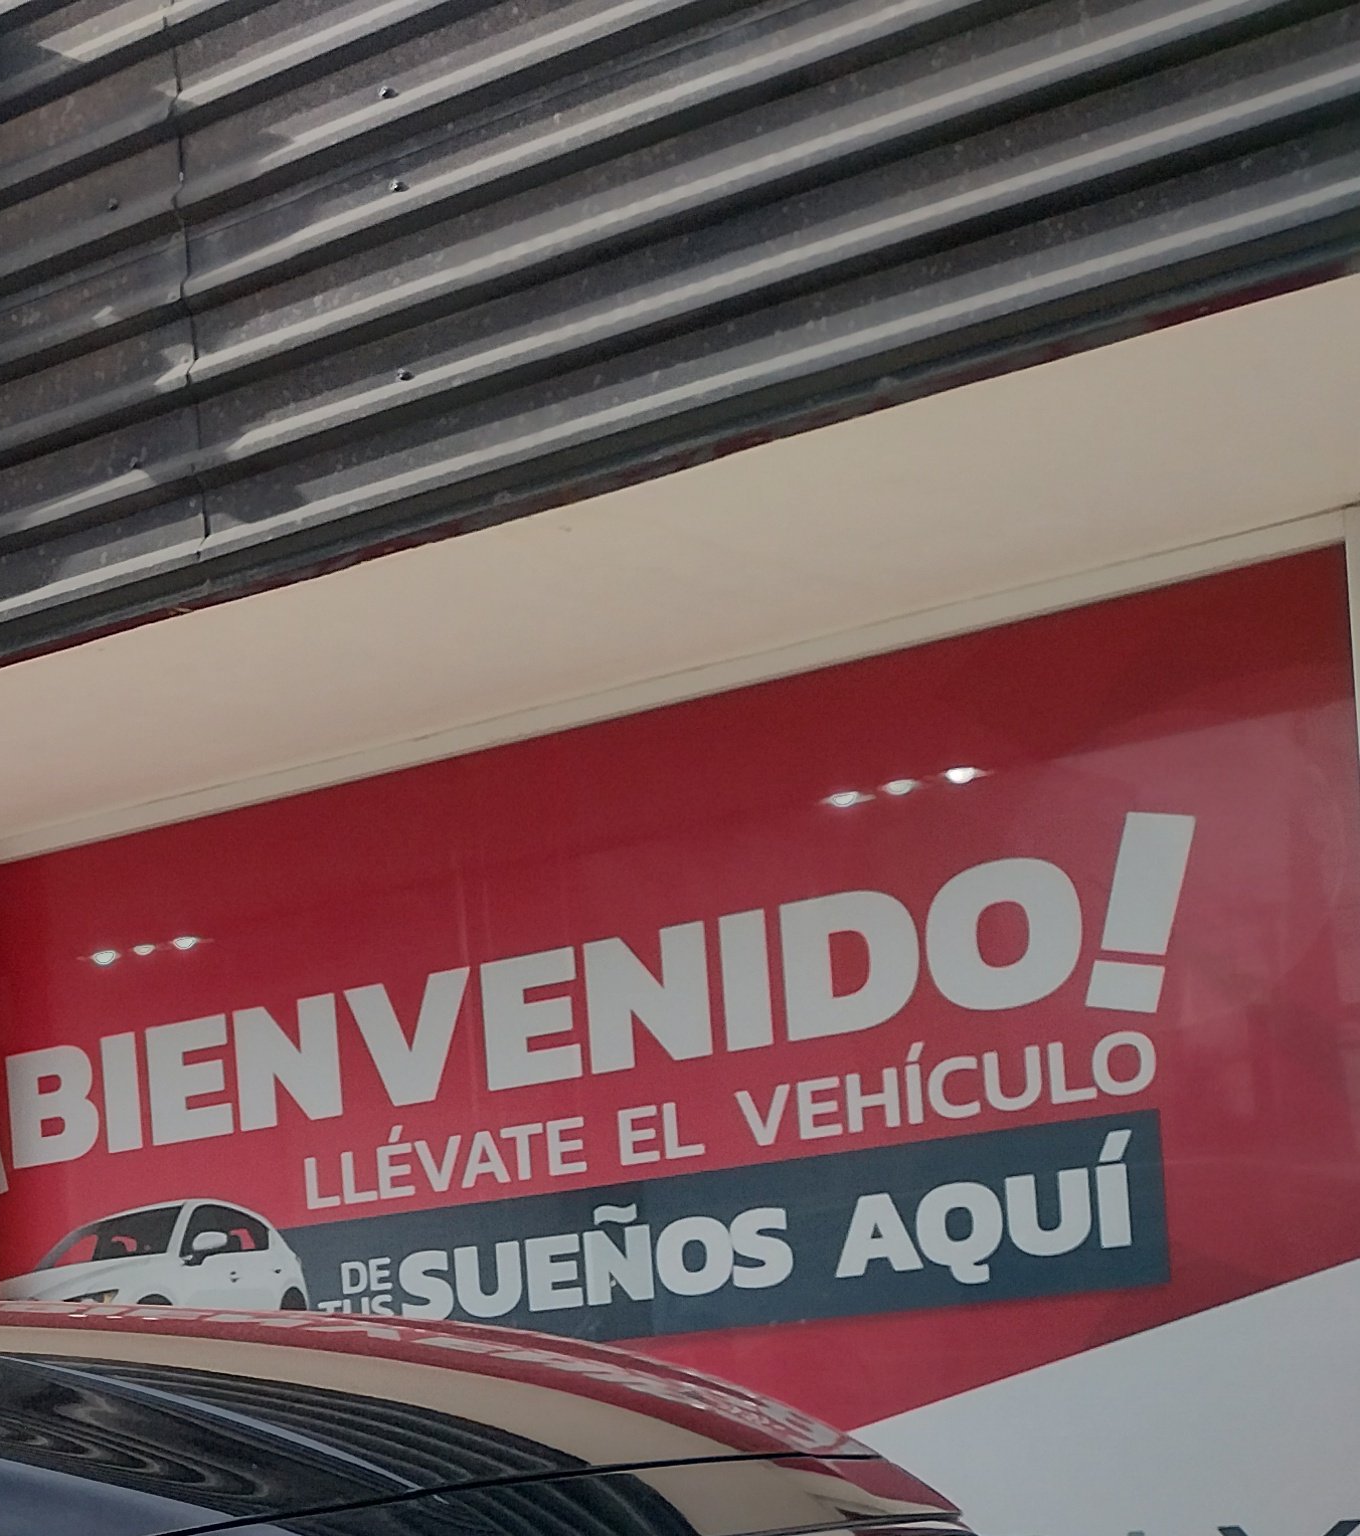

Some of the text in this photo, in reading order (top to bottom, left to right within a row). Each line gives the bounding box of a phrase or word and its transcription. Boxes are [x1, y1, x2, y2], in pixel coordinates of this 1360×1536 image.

[303, 1031, 1157, 1210] LLÉVATE EL VEHÍCULO
[340, 1256, 392, 1295] DE
[398, 1128, 1132, 1321] SUEÑOS AQUÍ
